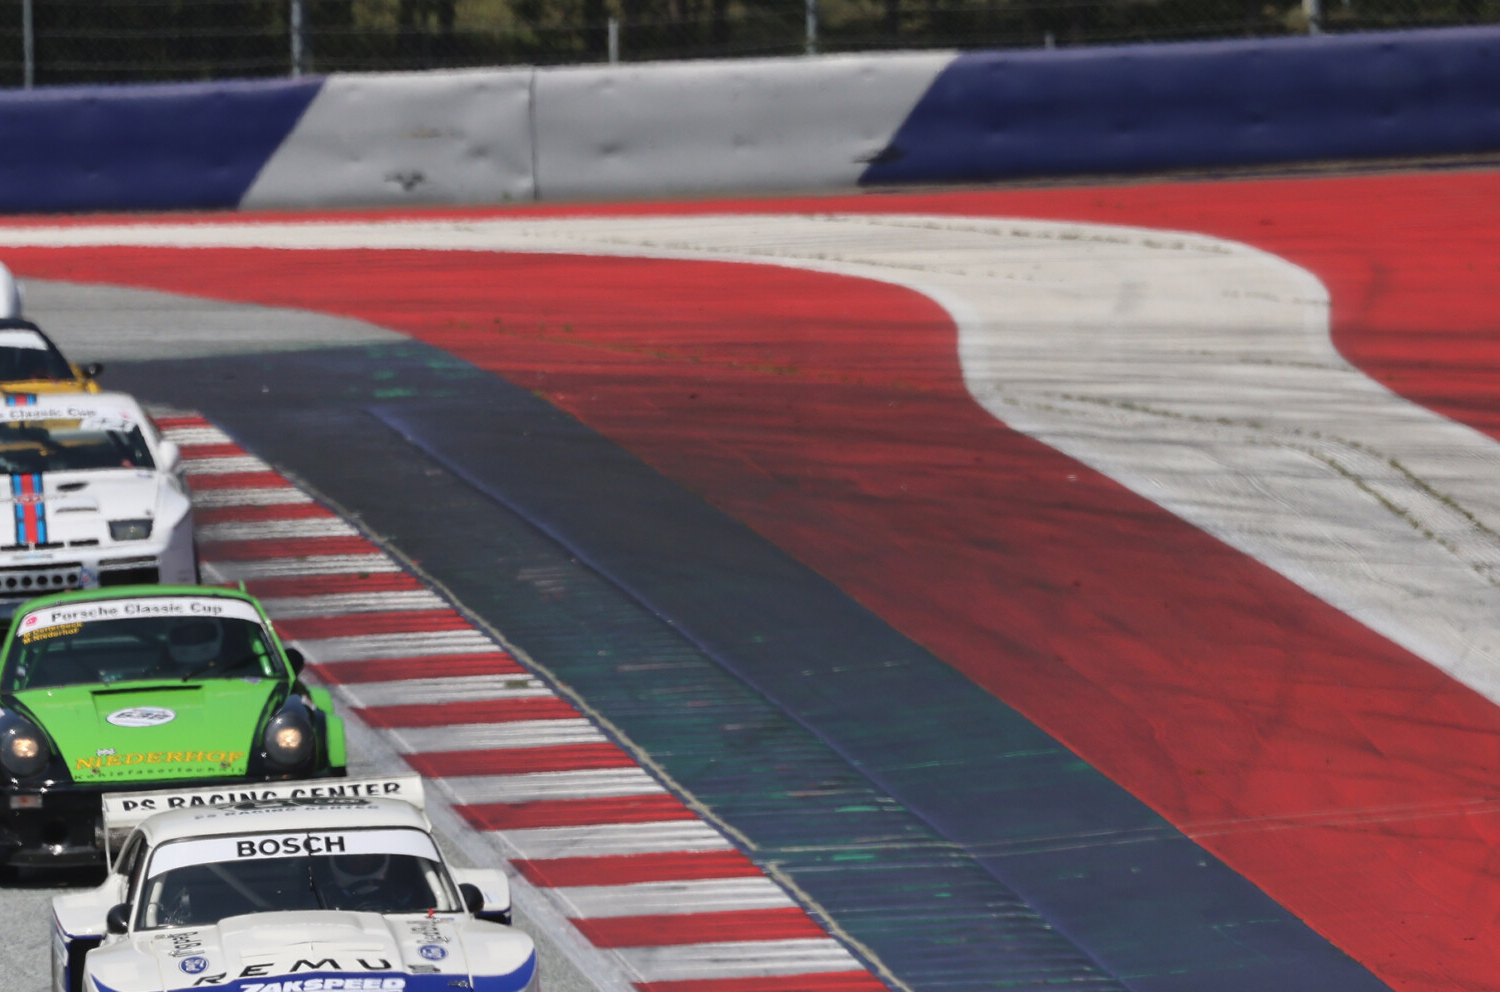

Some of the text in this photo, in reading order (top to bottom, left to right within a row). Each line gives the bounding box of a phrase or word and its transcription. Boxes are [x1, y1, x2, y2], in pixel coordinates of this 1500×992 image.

[51, 603, 223, 622] Porsche Classic Cup
[74, 750, 246, 770] NIEDERHOF
[123, 799, 156, 812] PS
[166, 791, 278, 809] RACING
[290, 781, 401, 798] CENTER
[235, 835, 346, 858] BOSCH
